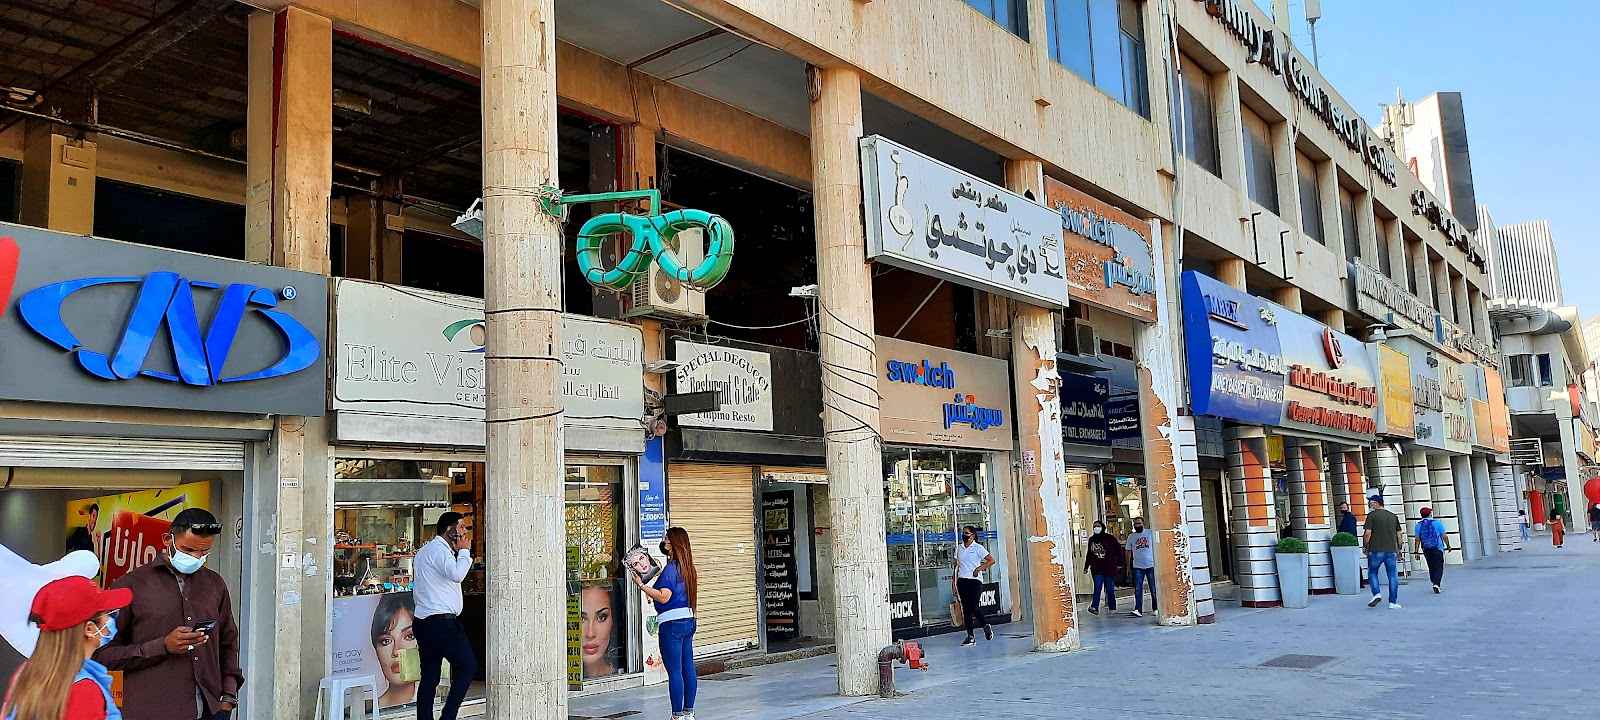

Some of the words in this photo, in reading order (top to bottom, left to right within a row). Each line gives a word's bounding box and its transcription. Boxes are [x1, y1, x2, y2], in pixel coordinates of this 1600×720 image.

[1060, 206, 1115, 248] switch
[1205, 294, 1241, 322] MBEX
[344, 343, 418, 385] Elite
[425, 351, 486, 388] Visi
[677, 350, 721, 384] SPECIAL
[723, 351, 769, 392] DEGUCCI
[887, 358, 955, 389] switch
[455, 392, 486, 403] CENT
[742, 377, 760, 405] Cafe
[732, 410, 756, 423] Resto
[1288, 400, 1320, 424] Geneve
[889, 600, 914, 620] HOCK
